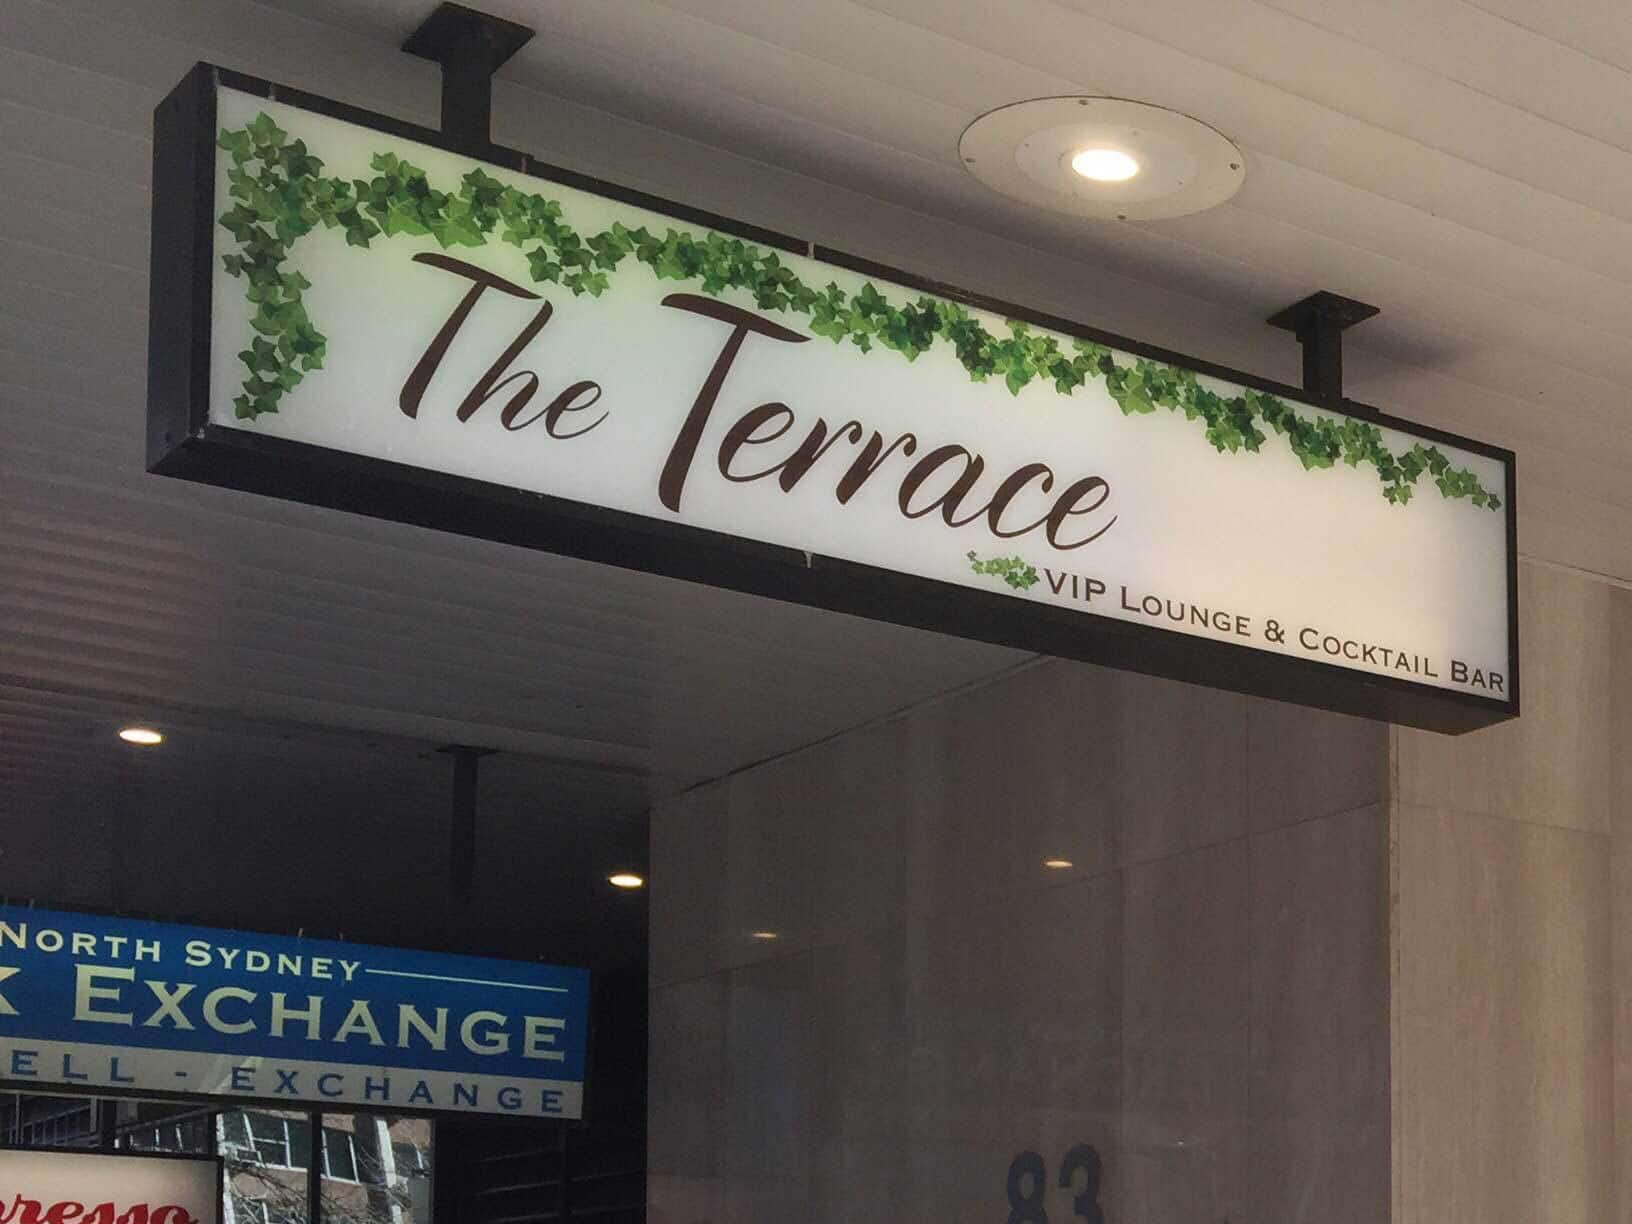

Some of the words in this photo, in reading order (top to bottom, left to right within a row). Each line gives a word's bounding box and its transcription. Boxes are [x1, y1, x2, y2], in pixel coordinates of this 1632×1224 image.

[400, 252, 609, 440] The
[658, 293, 1118, 551] Terrace
[1044, 568, 1106, 601] VIP
[1264, 619, 1285, 644] &
[230, 1066, 564, 1114] EXCHANGE
